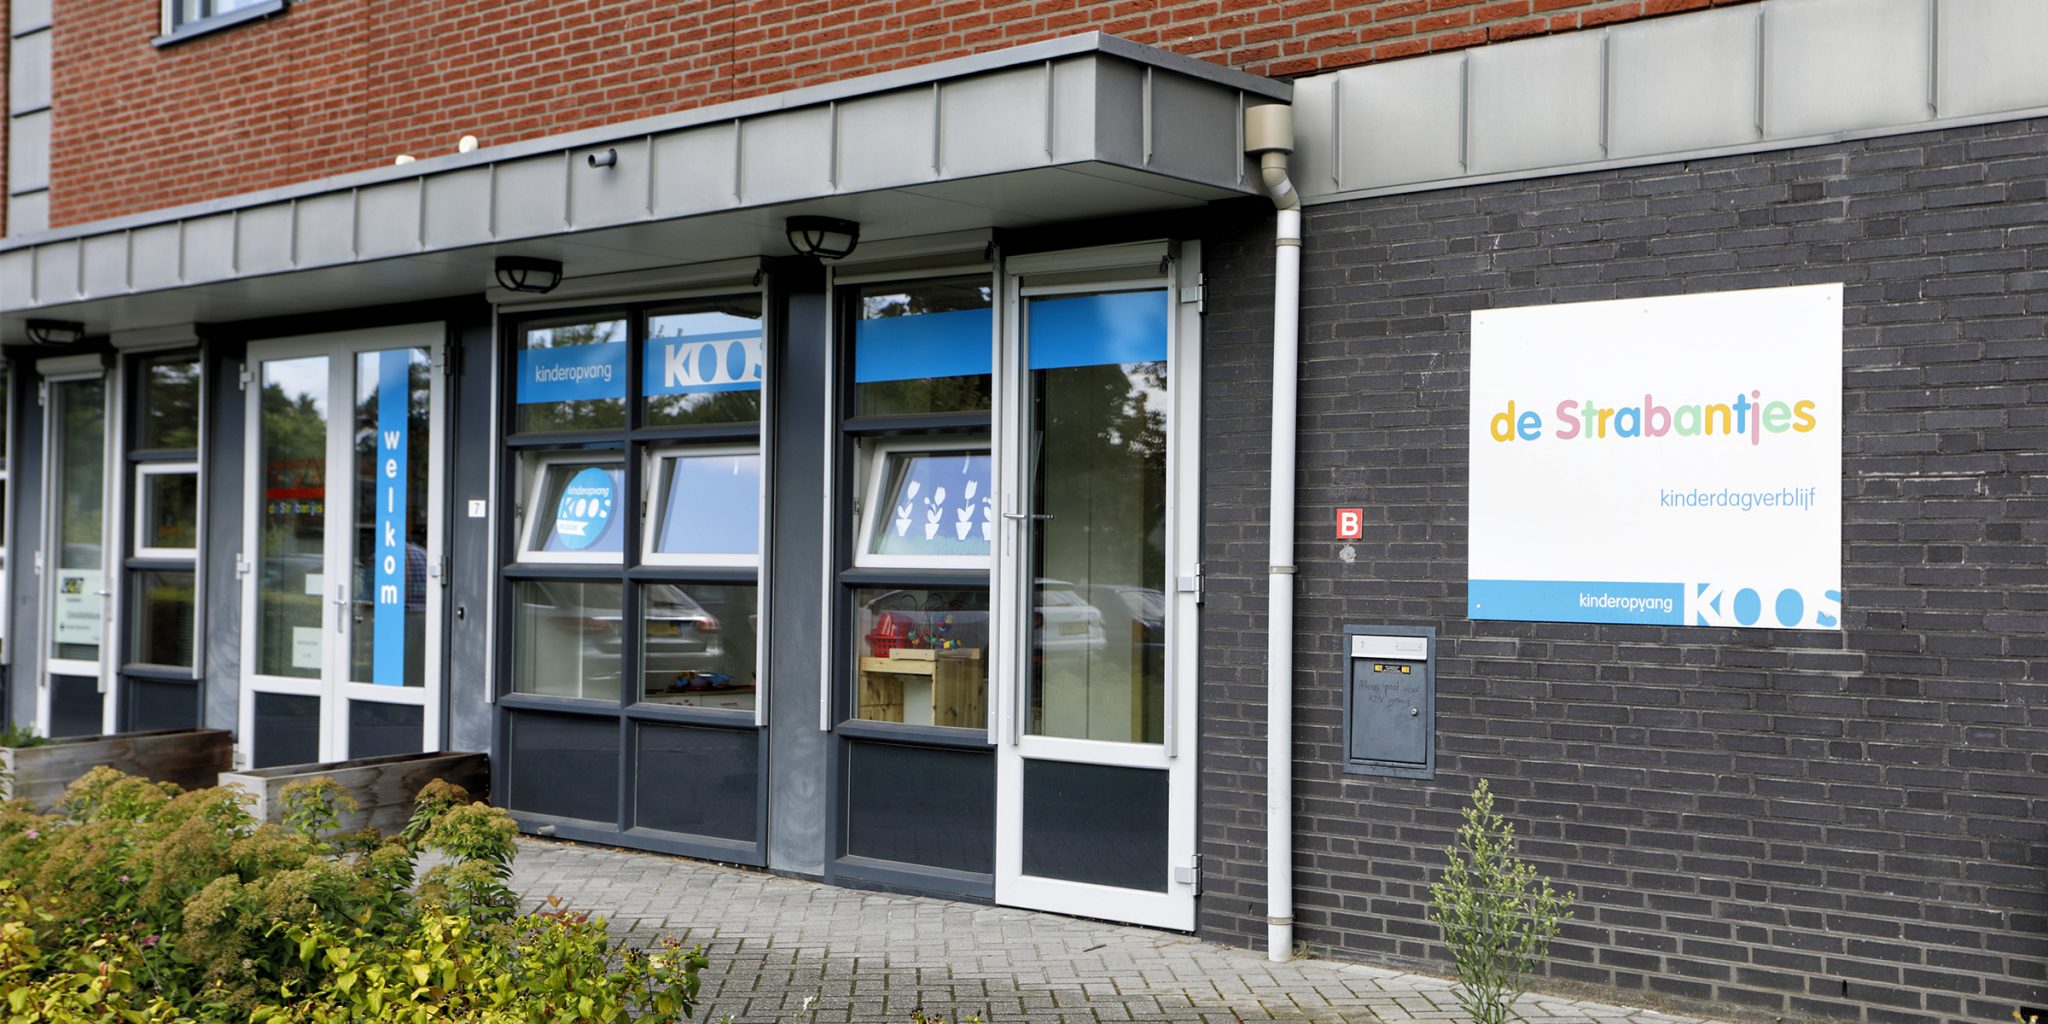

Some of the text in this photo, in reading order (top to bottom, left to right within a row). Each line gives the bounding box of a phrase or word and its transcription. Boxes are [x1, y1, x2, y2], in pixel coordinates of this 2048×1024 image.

[535, 363, 612, 384] kinderopvang
[1490, 389, 1816, 446] de Strabantjes
[567, 484, 610, 498] kinderopvang
[1660, 487, 1816, 511] kinderdagverblijf
[380, 430, 401, 604] welkom
[474, 502, 481, 515] 7
[557, 496, 612, 519] KOOS
[1341, 512, 1359, 536] B
[1579, 582, 1842, 629] kinderopvang KOOS
